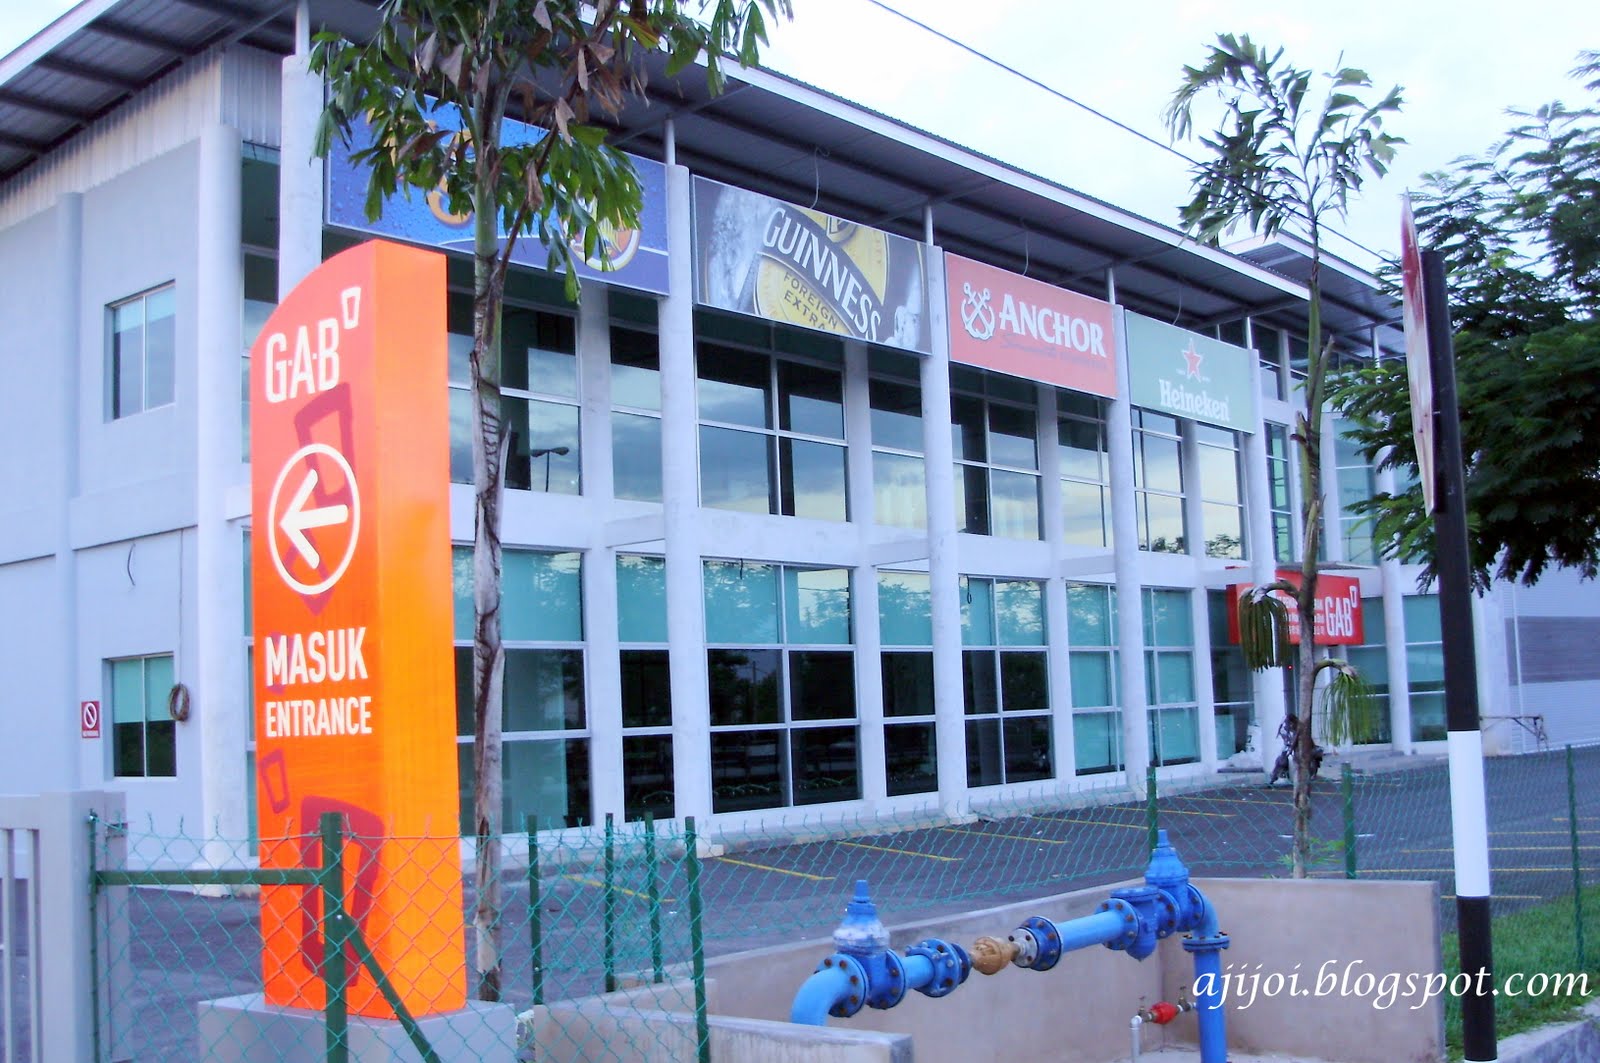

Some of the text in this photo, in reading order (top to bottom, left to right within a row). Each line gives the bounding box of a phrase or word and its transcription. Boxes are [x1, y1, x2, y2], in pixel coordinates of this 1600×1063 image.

[763, 207, 881, 342] GUINNESS
[783, 271, 839, 330] FOREIGN
[999, 293, 1107, 358] ANCHOR
[1159, 378, 1231, 422] Heineken
[264, 626, 369, 687] MASUK
[264, 695, 373, 738] ENTRANCE
